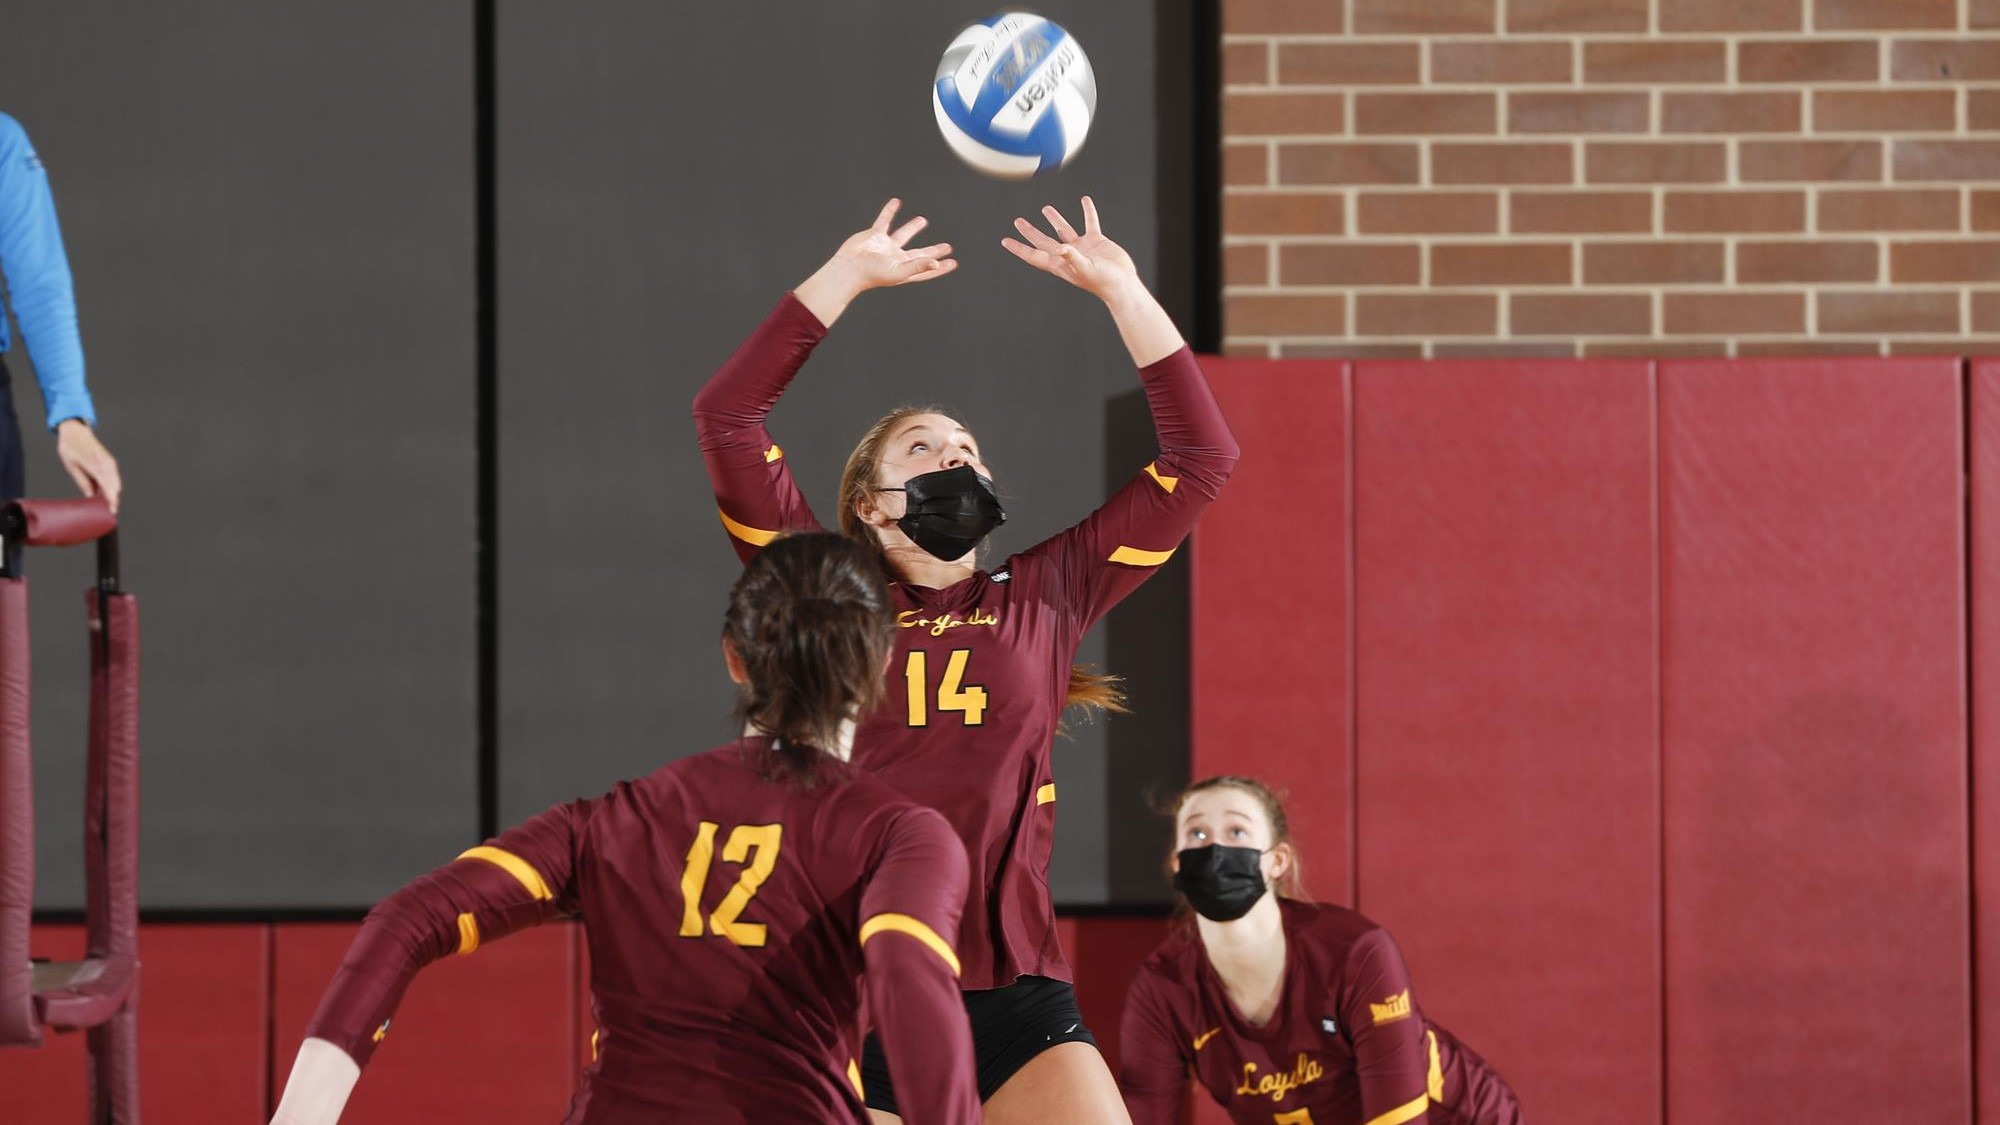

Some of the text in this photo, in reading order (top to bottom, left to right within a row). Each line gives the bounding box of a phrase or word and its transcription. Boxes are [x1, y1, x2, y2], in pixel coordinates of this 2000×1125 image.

[1015, 45, 1076, 113] molten
[905, 649, 988, 727] 14
[678, 820, 783, 947] 12
[1237, 1053, 1323, 1101] Loyola
